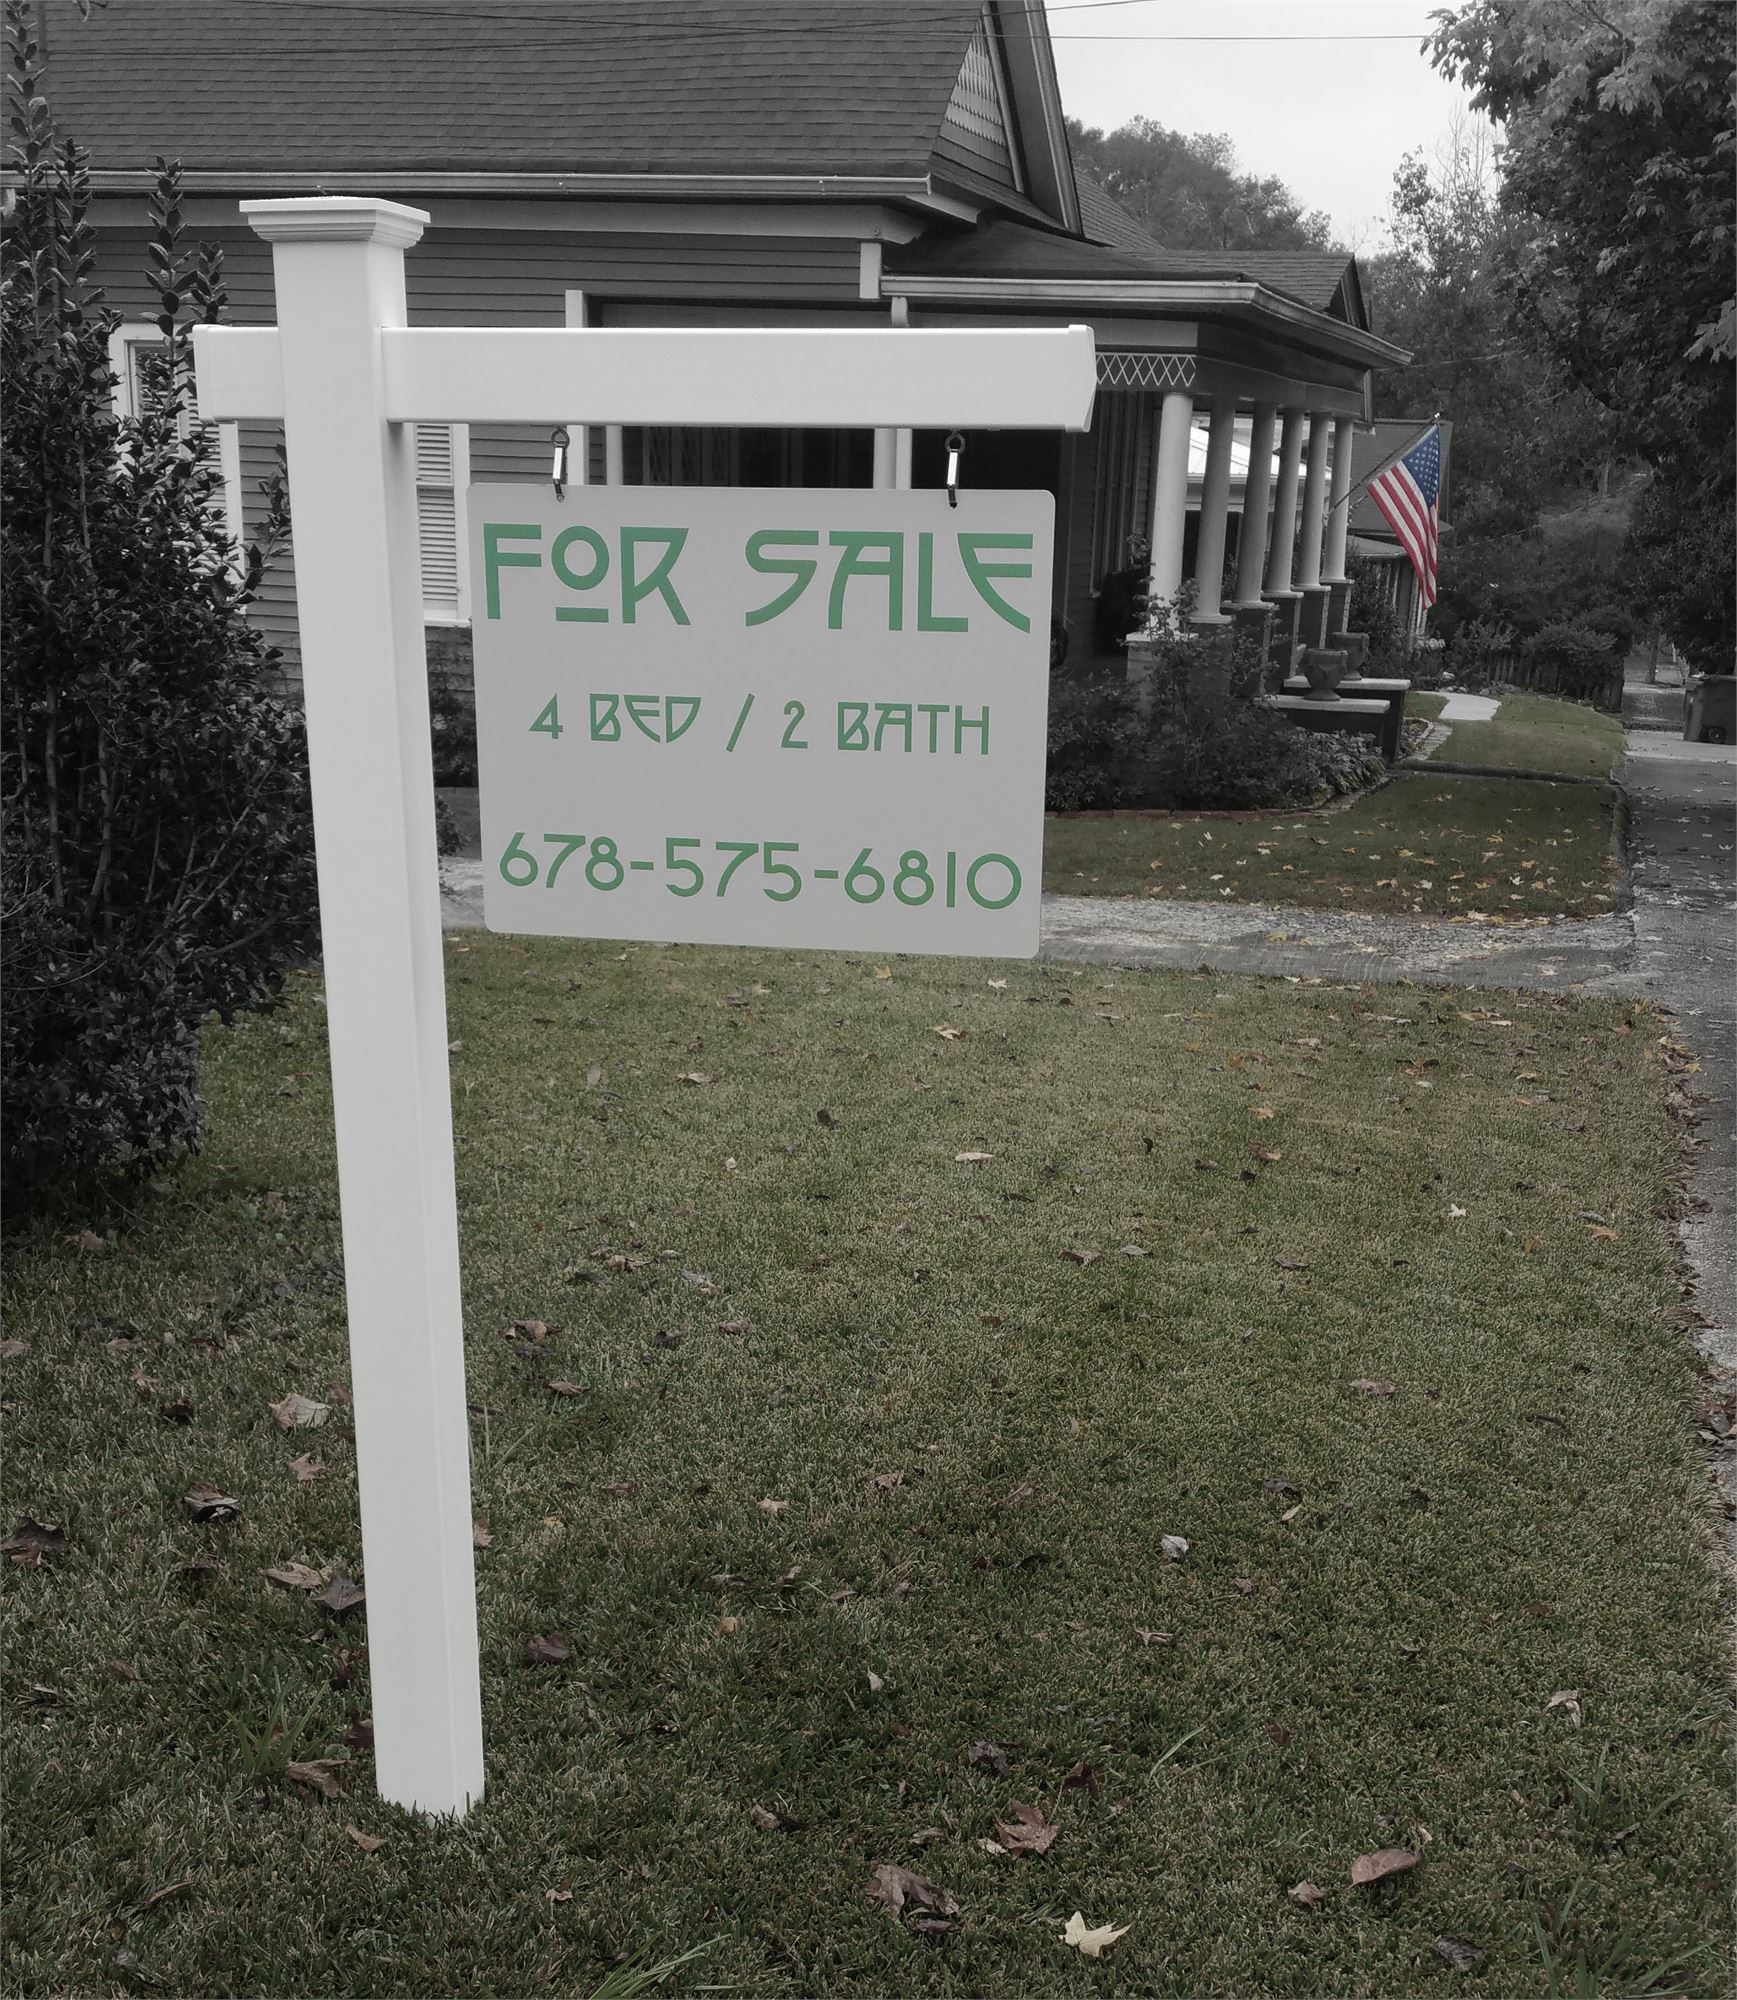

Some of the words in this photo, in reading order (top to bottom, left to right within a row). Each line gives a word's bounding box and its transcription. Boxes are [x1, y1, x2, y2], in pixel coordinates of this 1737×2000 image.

[483, 522, 691, 626] FOR
[745, 529, 1034, 634] SALE
[528, 693, 564, 741] 4
[589, 693, 702, 744] BED
[725, 693, 756, 753] /
[780, 700, 809, 750] 2
[837, 701, 990, 755] BATH
[499, 832, 1022, 910] 678-575-6810
